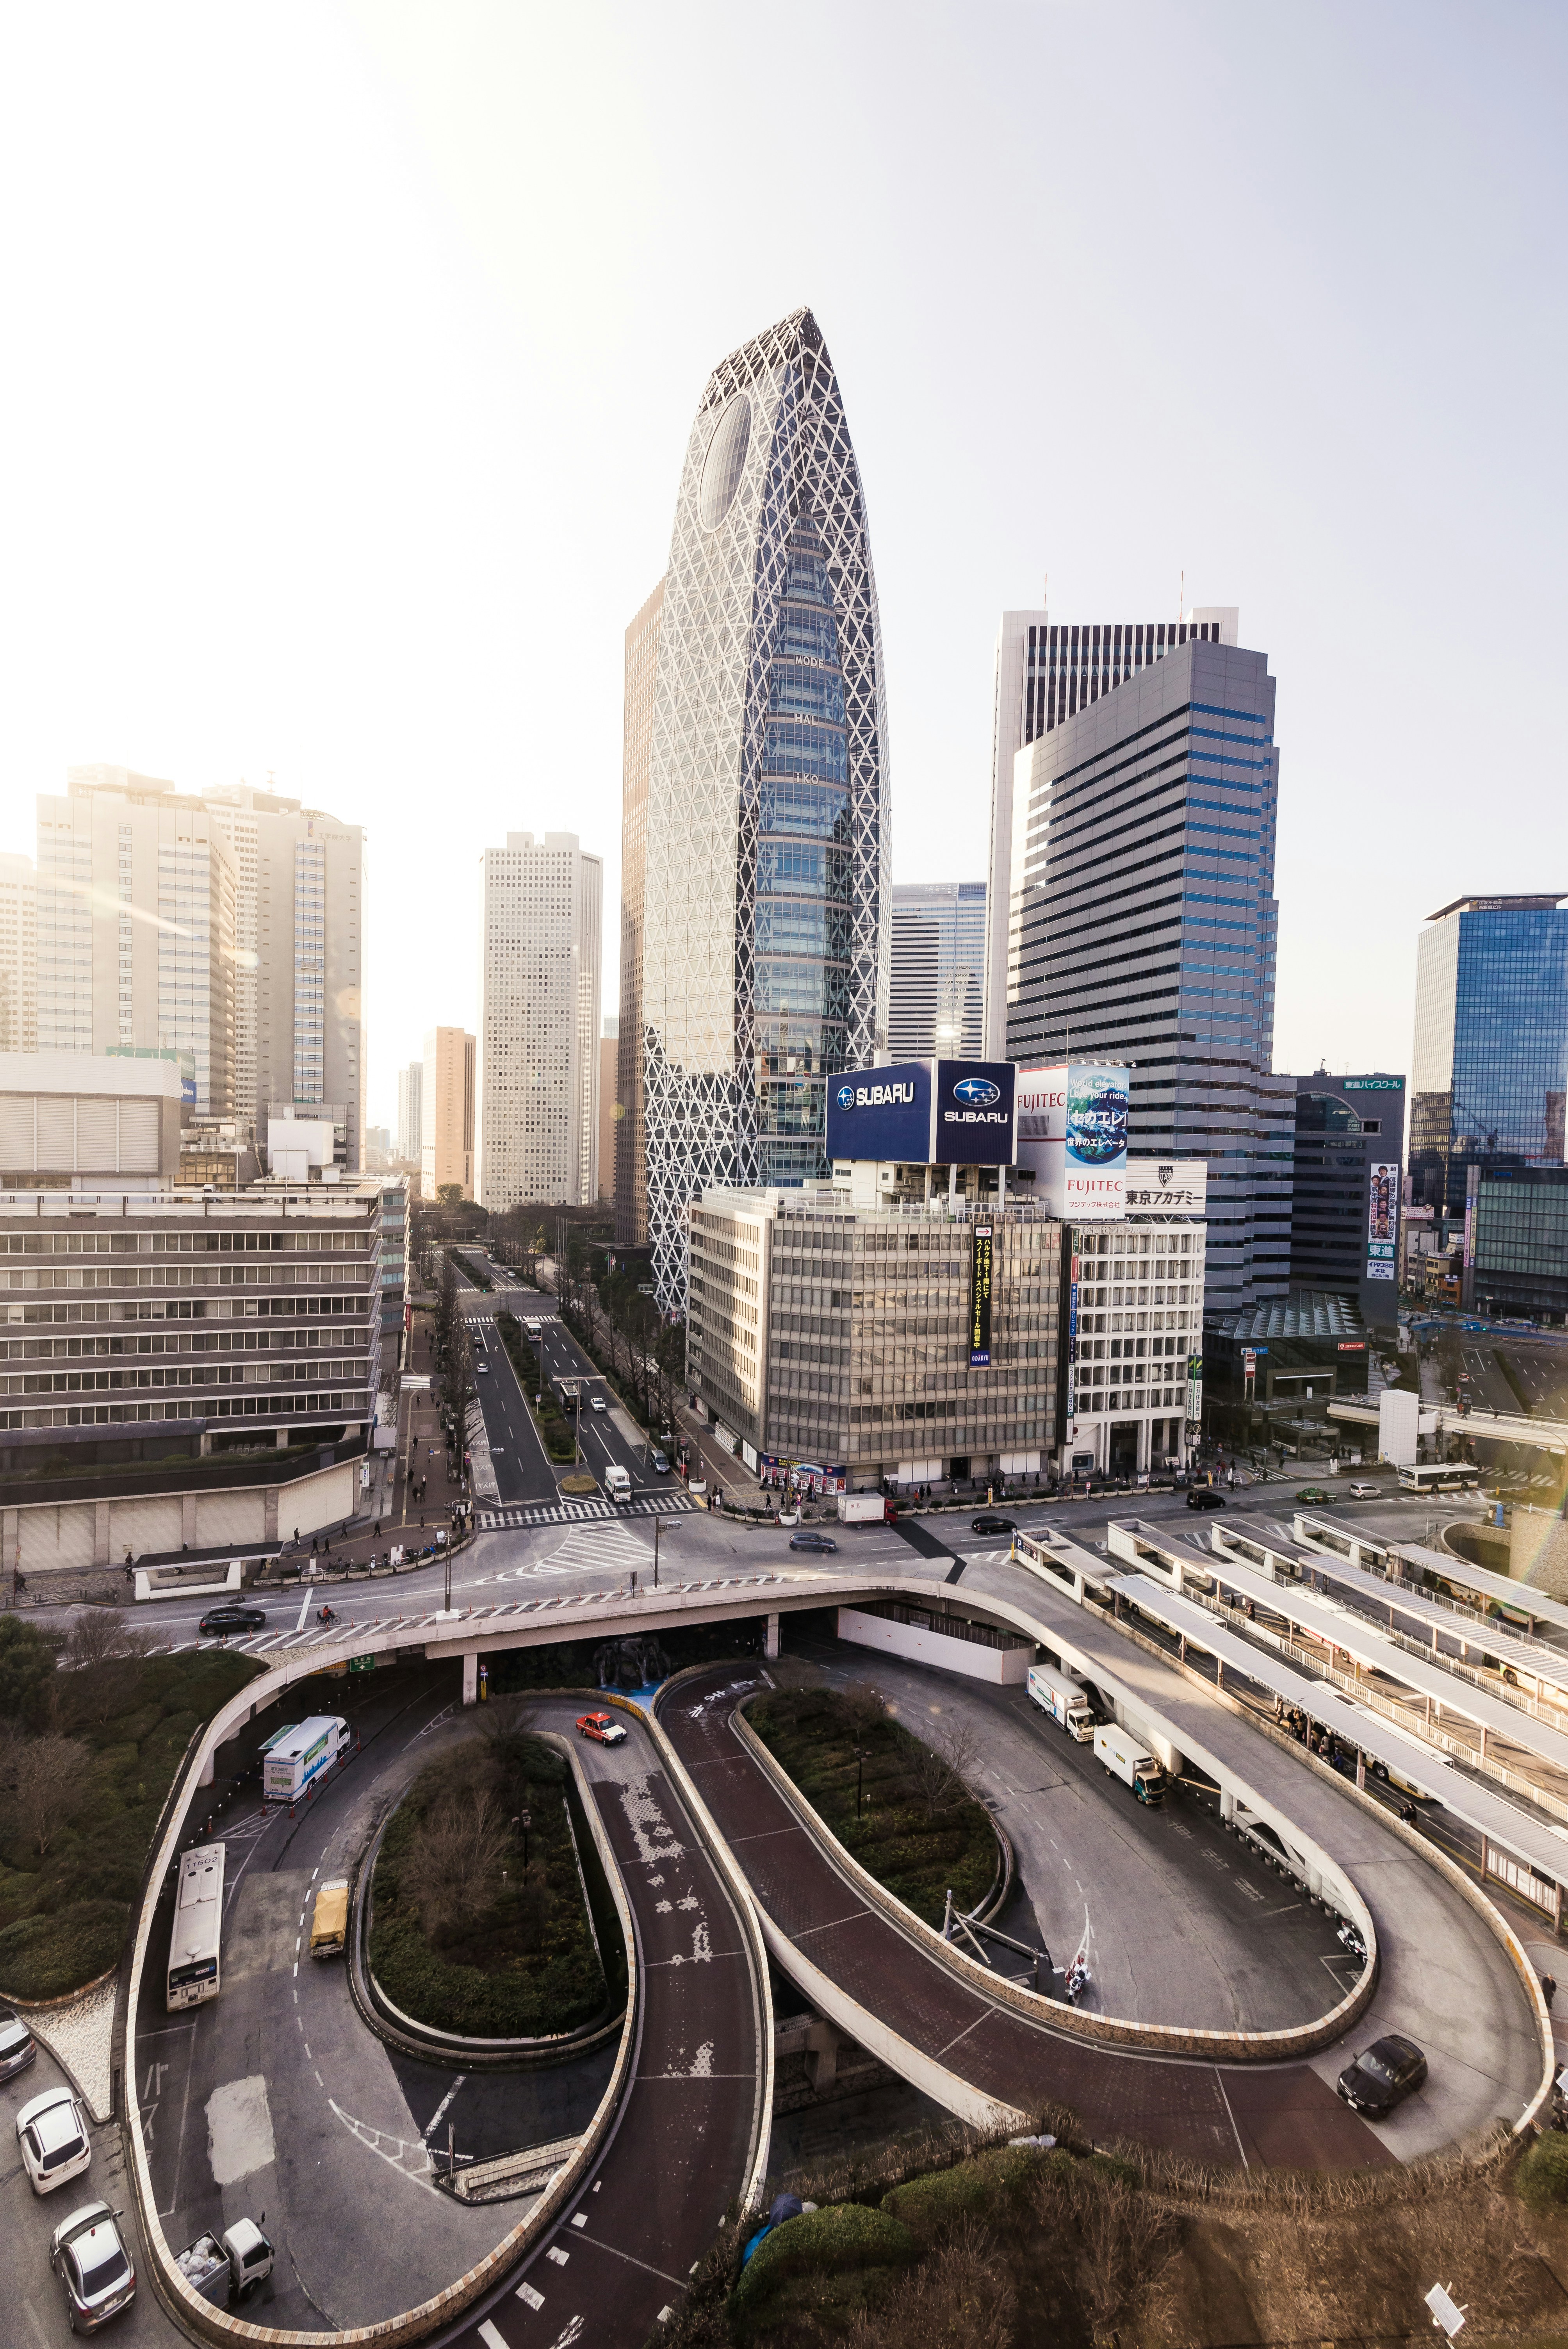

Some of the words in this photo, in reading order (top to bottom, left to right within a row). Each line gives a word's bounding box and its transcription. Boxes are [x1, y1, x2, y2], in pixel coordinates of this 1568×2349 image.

[1095, 1080, 1126, 1089] elevator.
[856, 1082, 914, 1106] SUBARU
[1018, 1093, 1065, 1114] FUJITEC
[944, 1111, 1008, 1123] SUBARU
[1067, 1137, 1125, 1148] 世界のエレベータ
[1067, 1180, 1123, 1195] FUJITEC
[1125, 1190, 1203, 1205] 東京アカデミー
[1388, 1166, 1397, 1237] 超一流講師の授業に無料招待
[1369, 1245, 1393, 1257] 東進
[974, 1280, 982, 1348] スペシャルセール開催中
[1018, 1539, 1022, 1547] P
[186, 1857, 217, 1869] 11502
